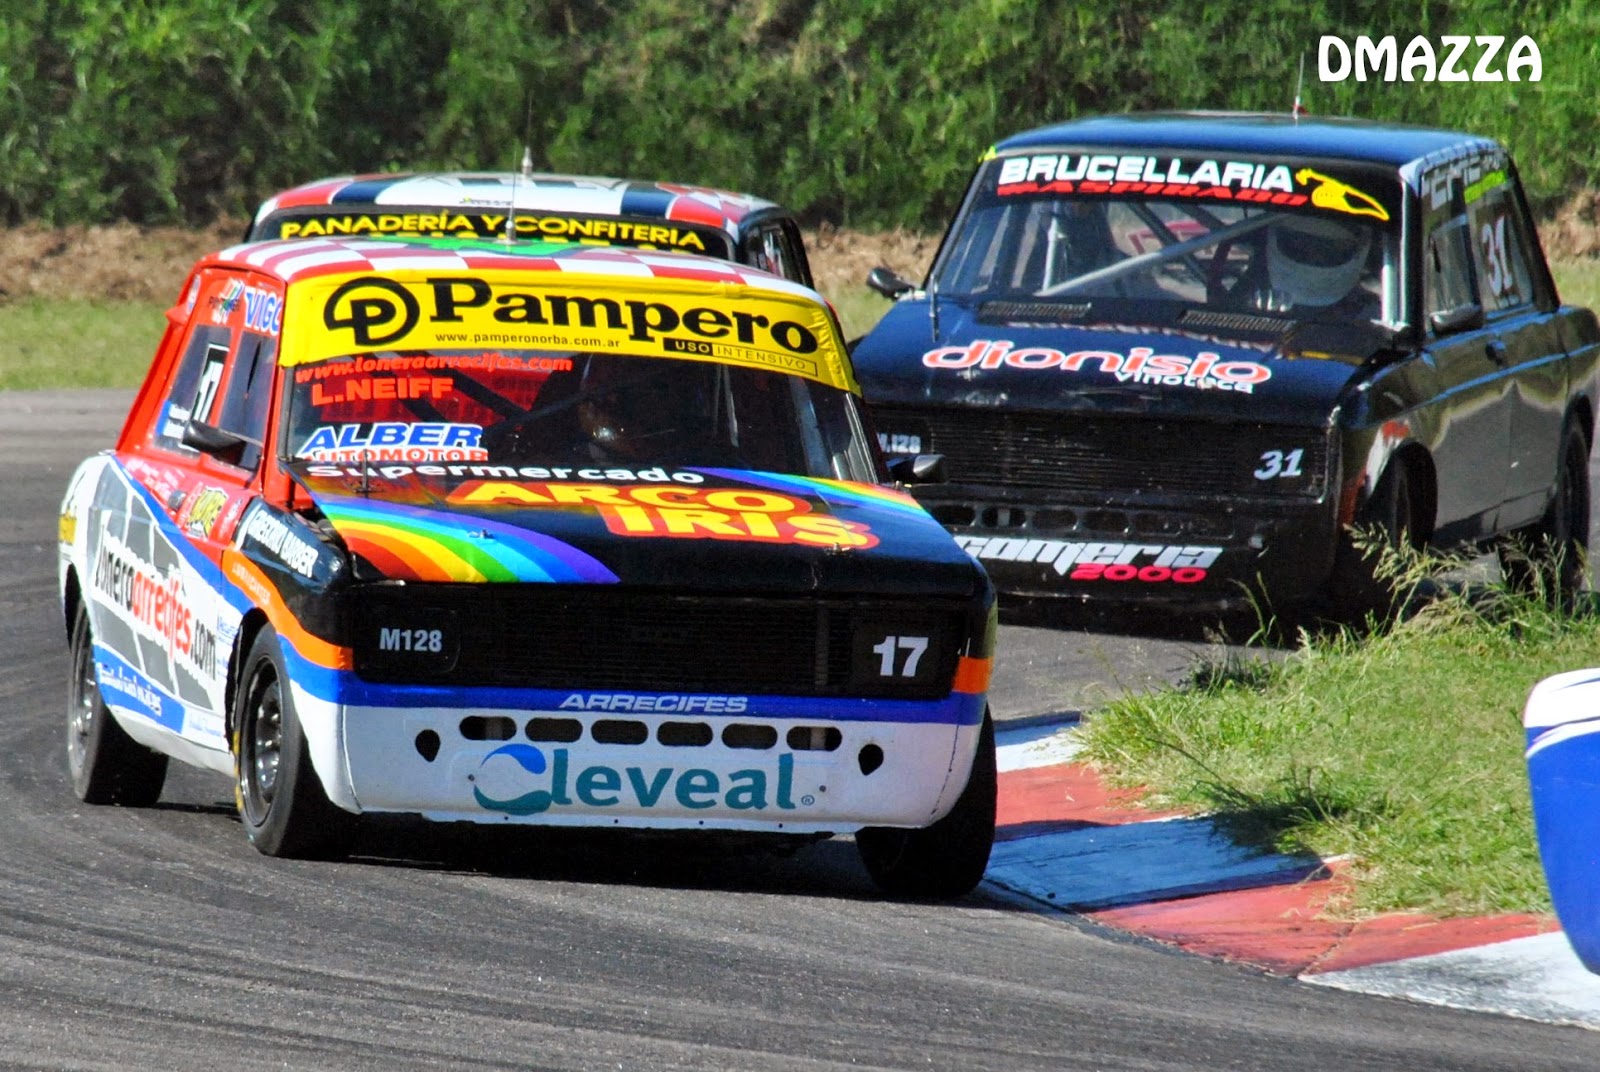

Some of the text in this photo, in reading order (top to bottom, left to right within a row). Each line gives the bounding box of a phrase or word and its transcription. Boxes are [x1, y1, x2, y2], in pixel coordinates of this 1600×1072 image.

[998, 156, 1294, 193] BRUCELLARIA
[280, 209, 474, 239] PANADERÍA
[480, 214, 506, 231] Y
[514, 215, 705, 250] CONFITERIA
[1482, 214, 1514, 297] 31
[426, 277, 818, 354] Pampero
[435, 332, 621, 349] www.pamperonorba.com.ar
[675, 340, 806, 369] USO INTENSIVO
[296, 352, 573, 383] www.loneraarrecifes.com
[922, 340, 1272, 384] dionisio
[312, 377, 453, 406] L.NEIFF
[1115, 372, 1253, 394] vinoteca
[298, 422, 483, 458] ALBER
[301, 448, 488, 462] AUTOMOTOR
[306, 464, 704, 484] Supermercado
[1254, 449, 1304, 480] 31
[456, 481, 797, 515] ARCO
[613, 504, 870, 548] IRIS
[1070, 563, 1207, 583] 2000
[379, 628, 442, 653] M128
[873, 636, 929, 679] 17
[559, 693, 748, 714] ARRECIFES
